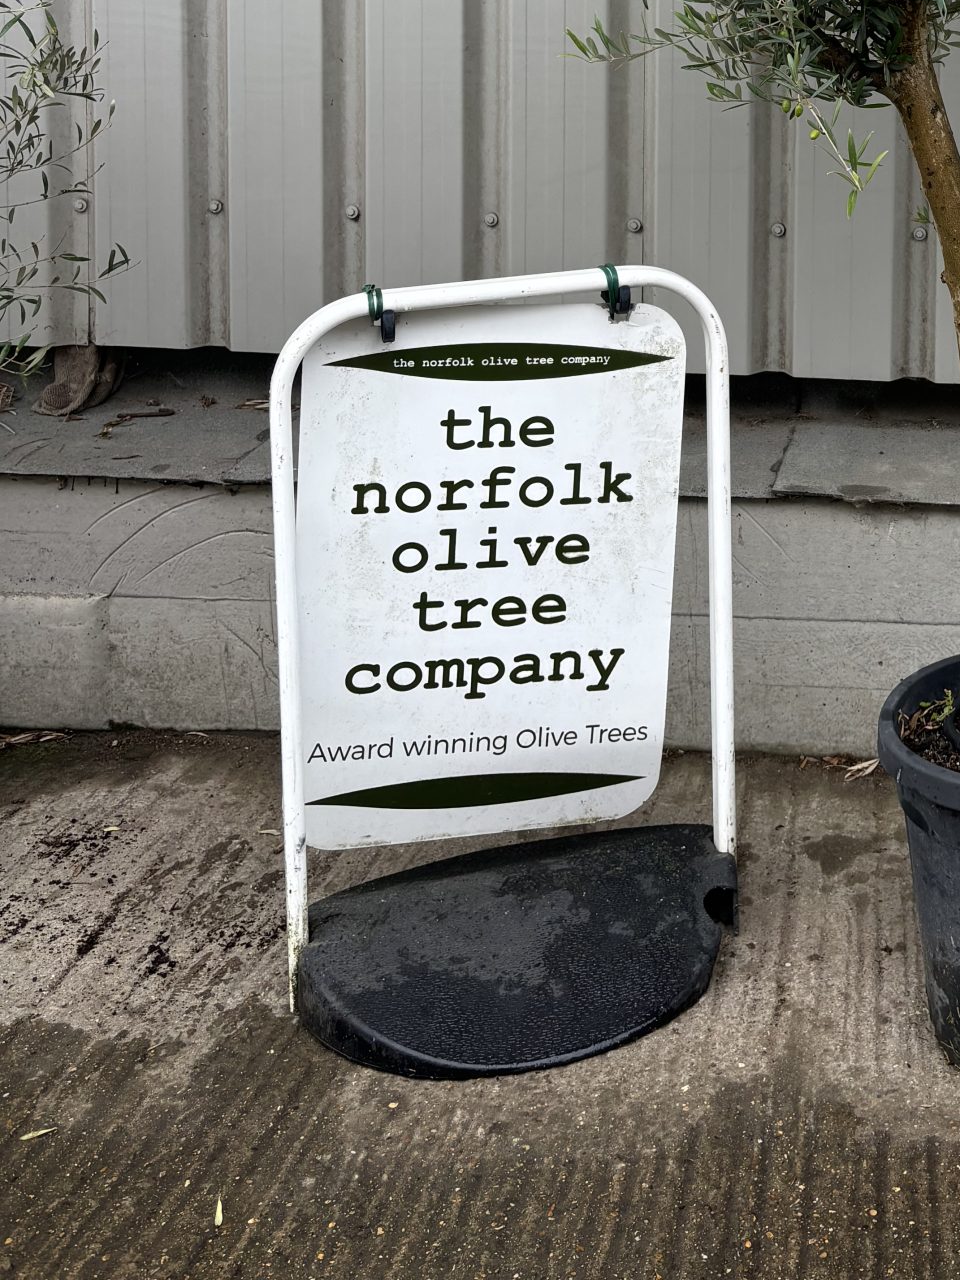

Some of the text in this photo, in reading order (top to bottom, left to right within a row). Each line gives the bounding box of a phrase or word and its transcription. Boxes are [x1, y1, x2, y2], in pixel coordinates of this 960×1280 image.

[393, 354, 611, 368] the norfolk olive tree company
[440, 405, 555, 451] the
[350, 461, 634, 515] norfolk
[392, 526, 590, 574] olive
[412, 591, 567, 632] tree
[344, 648, 625, 700] company
[307, 724, 648, 764] Award winning Olive Trees
